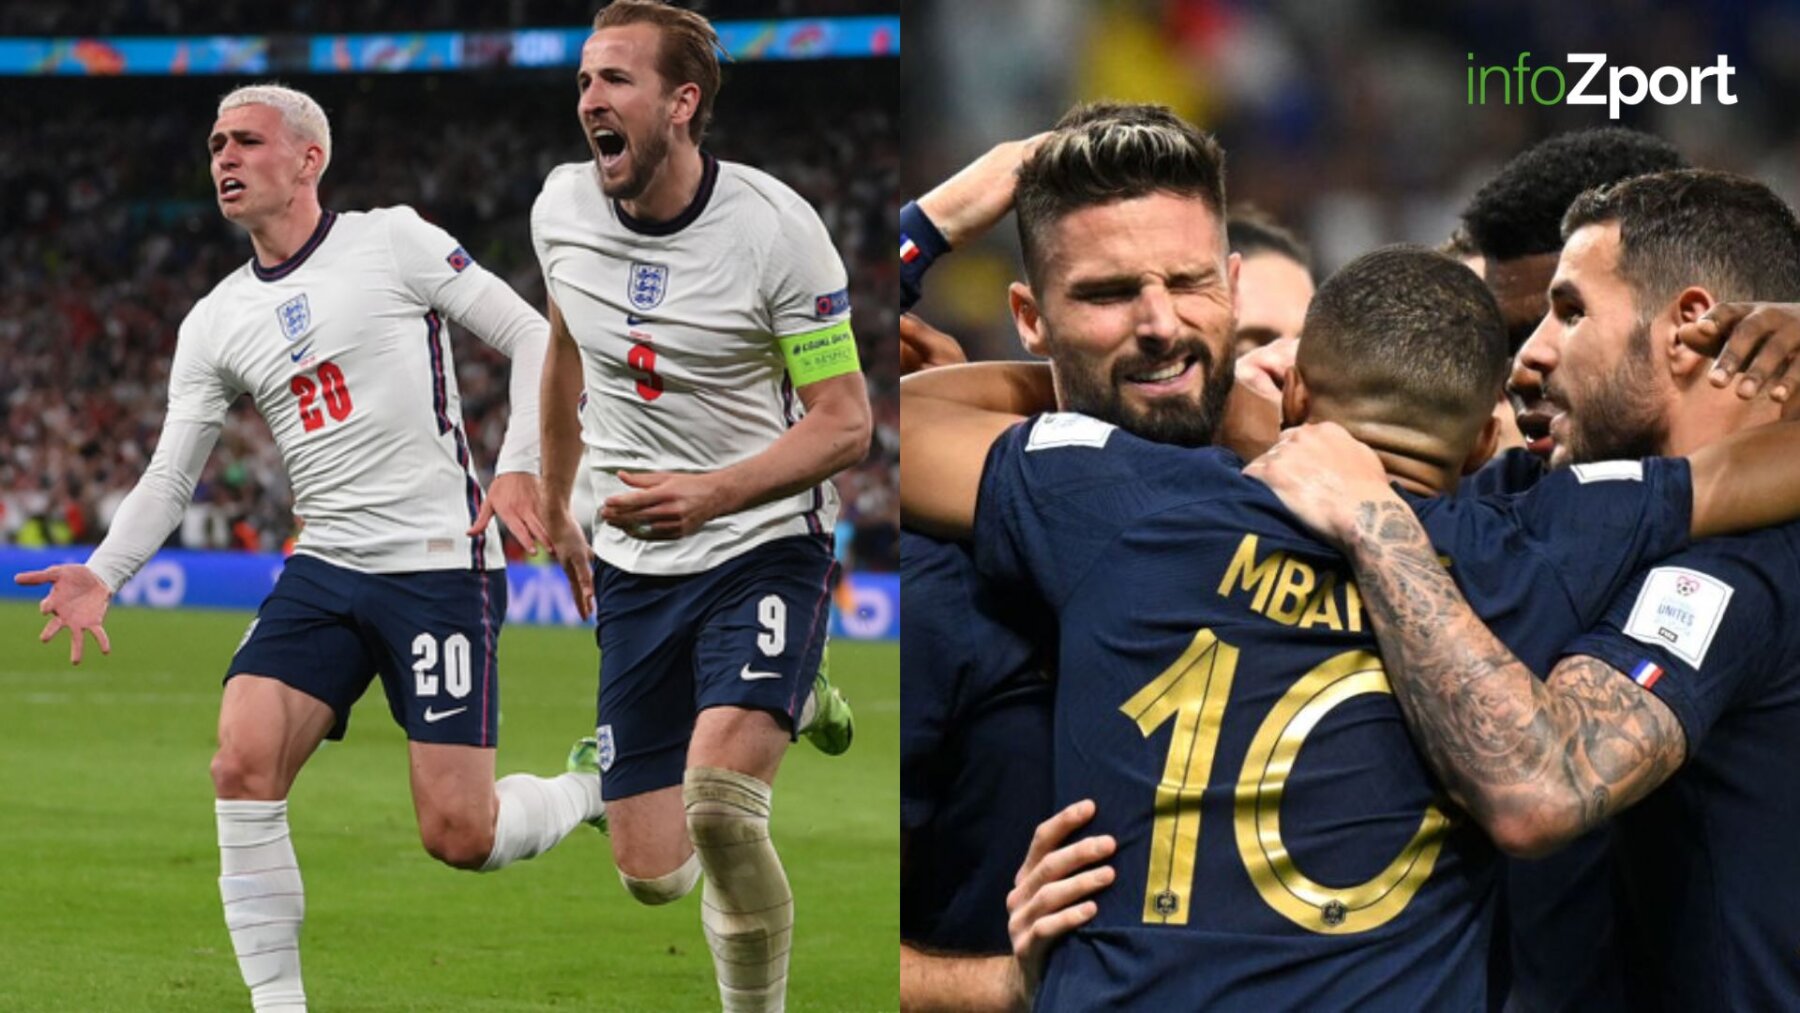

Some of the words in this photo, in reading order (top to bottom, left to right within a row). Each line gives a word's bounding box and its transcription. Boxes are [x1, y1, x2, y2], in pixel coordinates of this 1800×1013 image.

[290, 360, 354, 433] 20
[627, 343, 664, 401] 9
[756, 594, 787, 657] 9
[1657, 603, 1695, 627] UNITES
[411, 632, 472, 699] 20
[1118, 627, 1450, 936] 10
